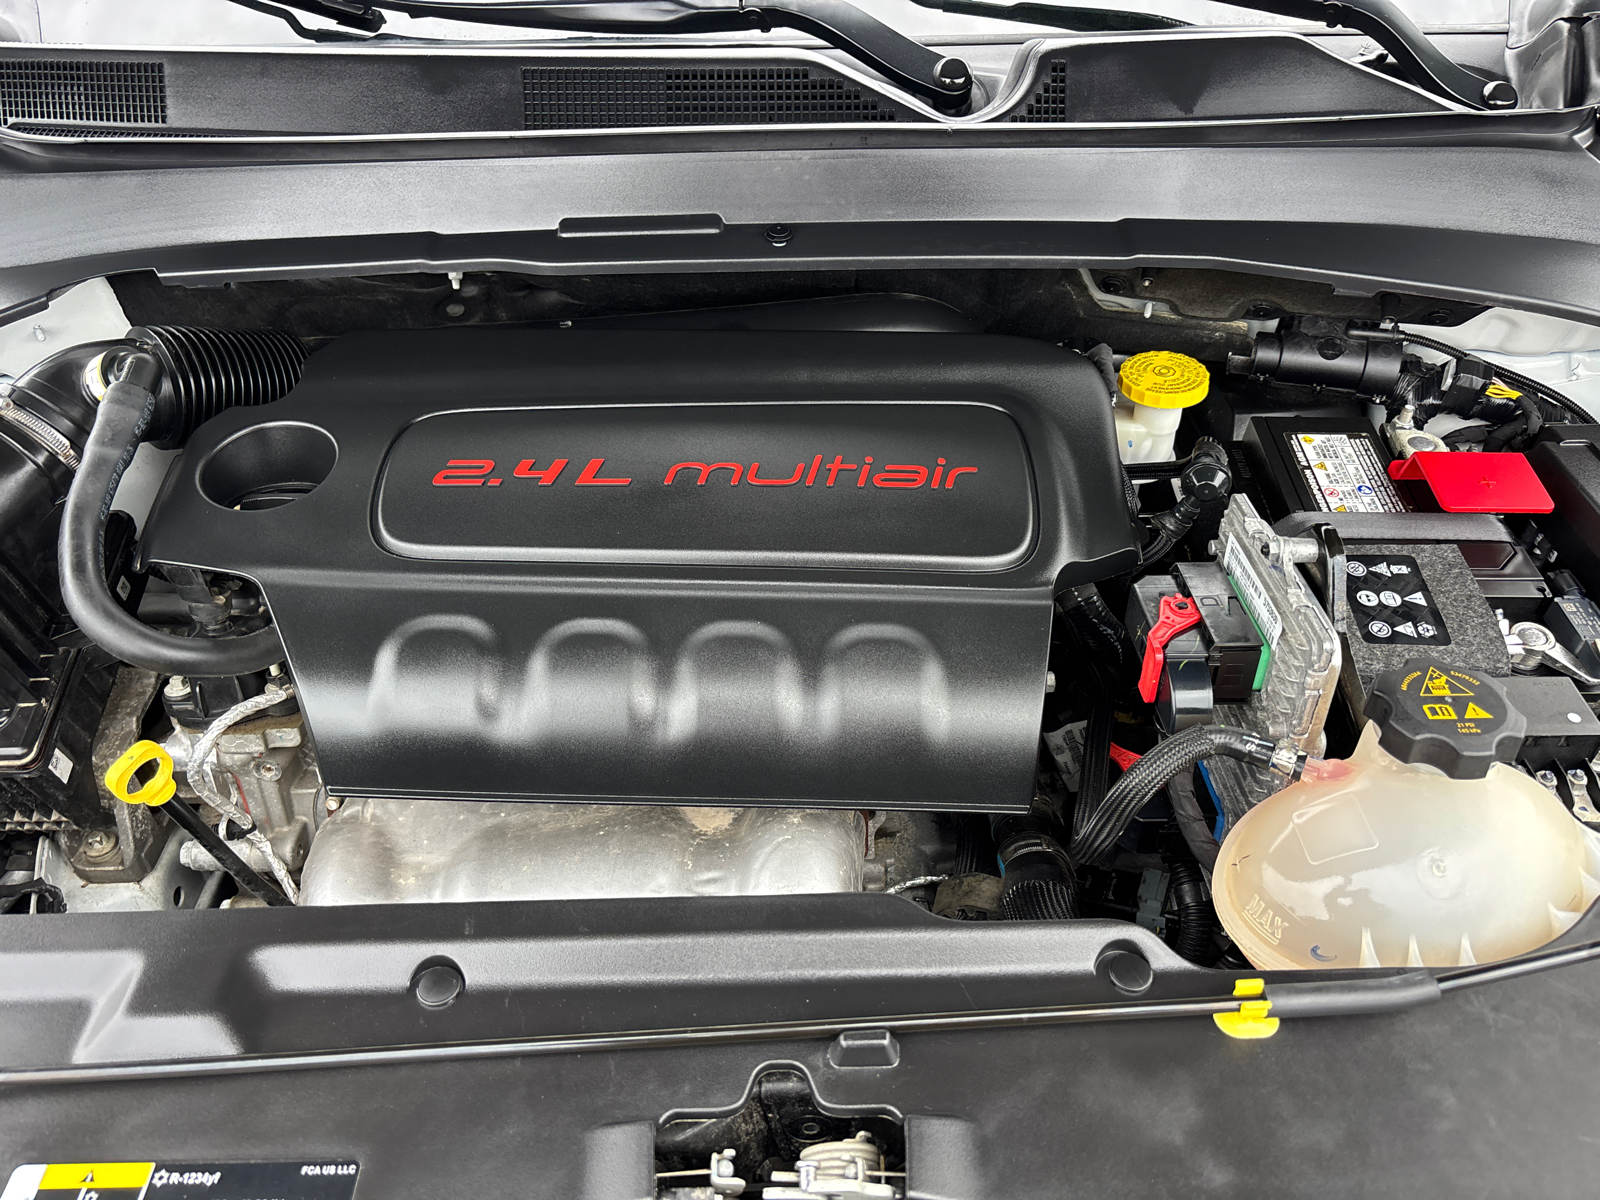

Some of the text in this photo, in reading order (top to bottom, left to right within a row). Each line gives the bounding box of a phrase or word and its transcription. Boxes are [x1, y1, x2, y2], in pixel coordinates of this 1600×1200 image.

[663, 454, 978, 490] multiair
[1245, 893, 1290, 939] MAX
[168, 1171, 222, 1187] R-1234yf
[301, 1164, 357, 1176] FCA US LLC
